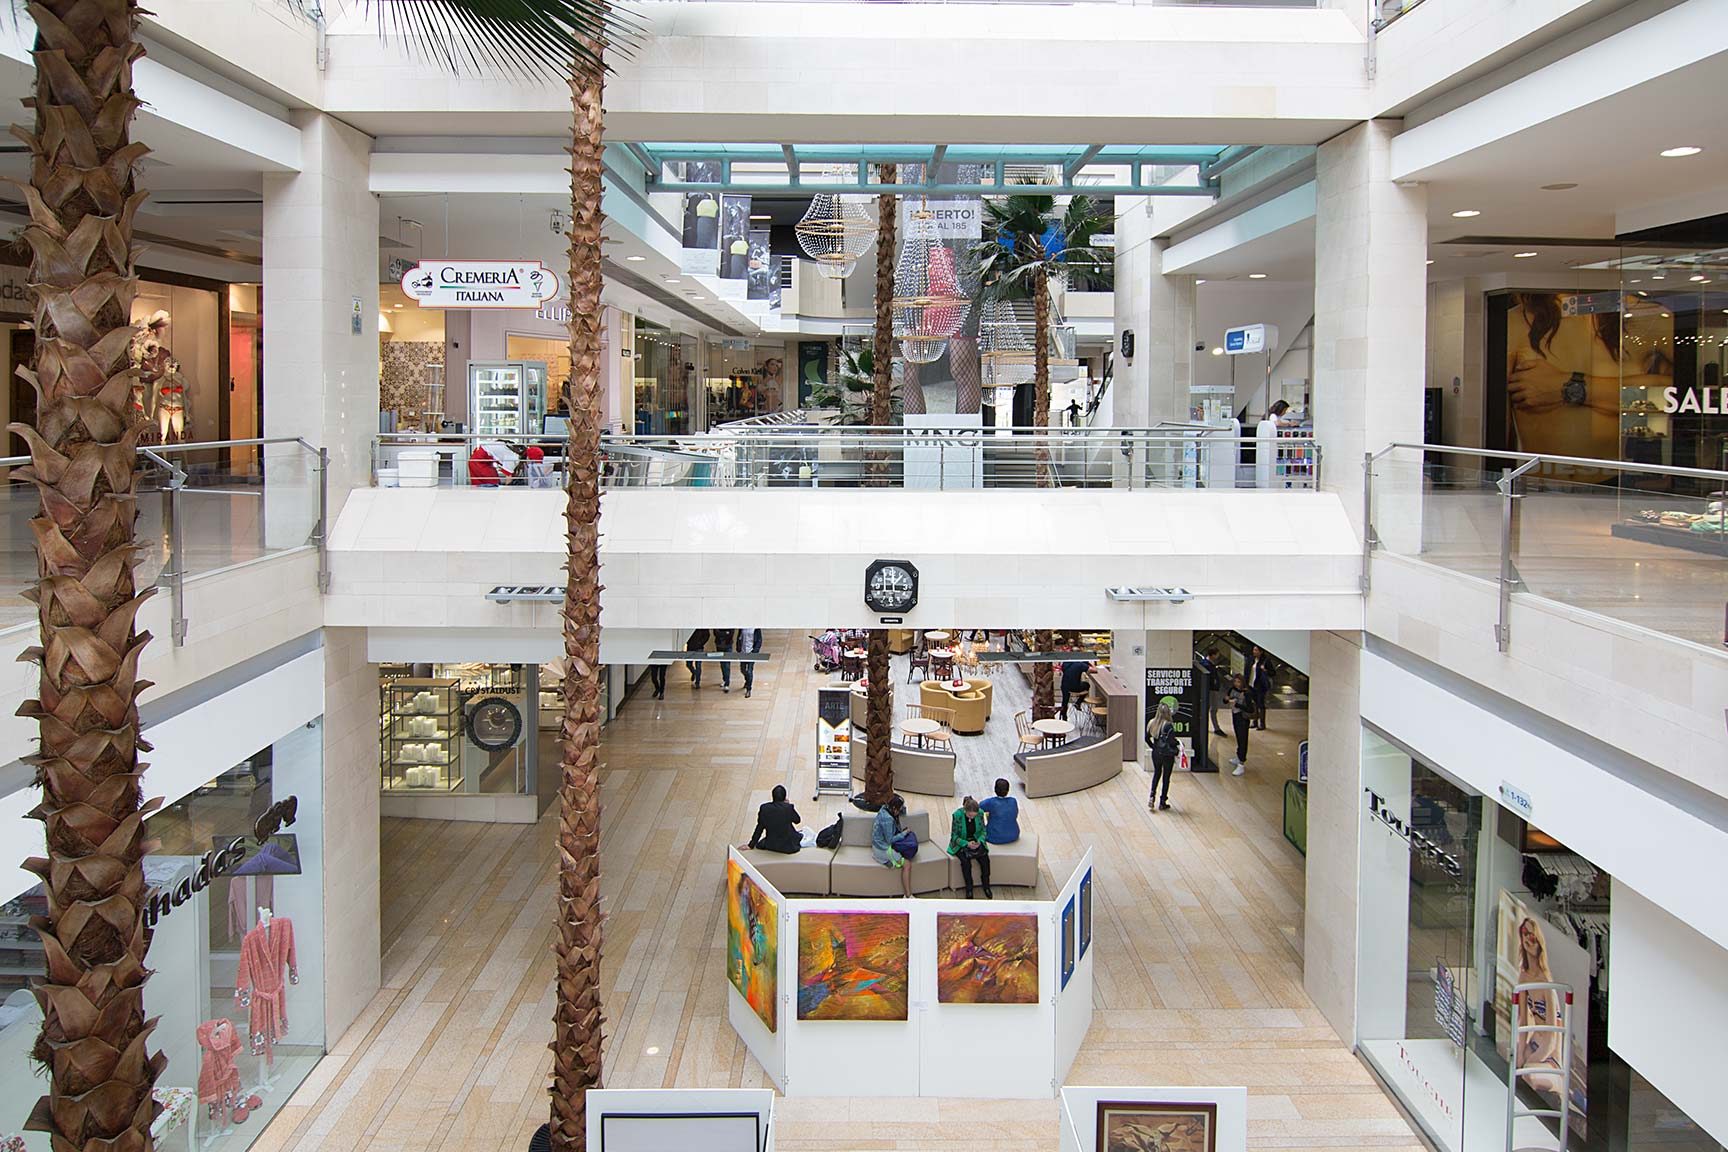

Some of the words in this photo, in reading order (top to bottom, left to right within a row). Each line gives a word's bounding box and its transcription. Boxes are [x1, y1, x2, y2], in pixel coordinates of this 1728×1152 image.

[952, 222, 967, 230] 185
[440, 267, 520, 284] CREMERIA
[456, 291, 504, 302] ITALIANA
[140, 431, 193, 443] MIRANDA
[1147, 670, 1180, 678] SERVICIO
[1181, 670, 1191, 678] DE
[1146, 678, 1192, 686] TRANSPORTE
[1155, 686, 1183, 694] SEGURO
[824, 702, 845, 710] ARTE
